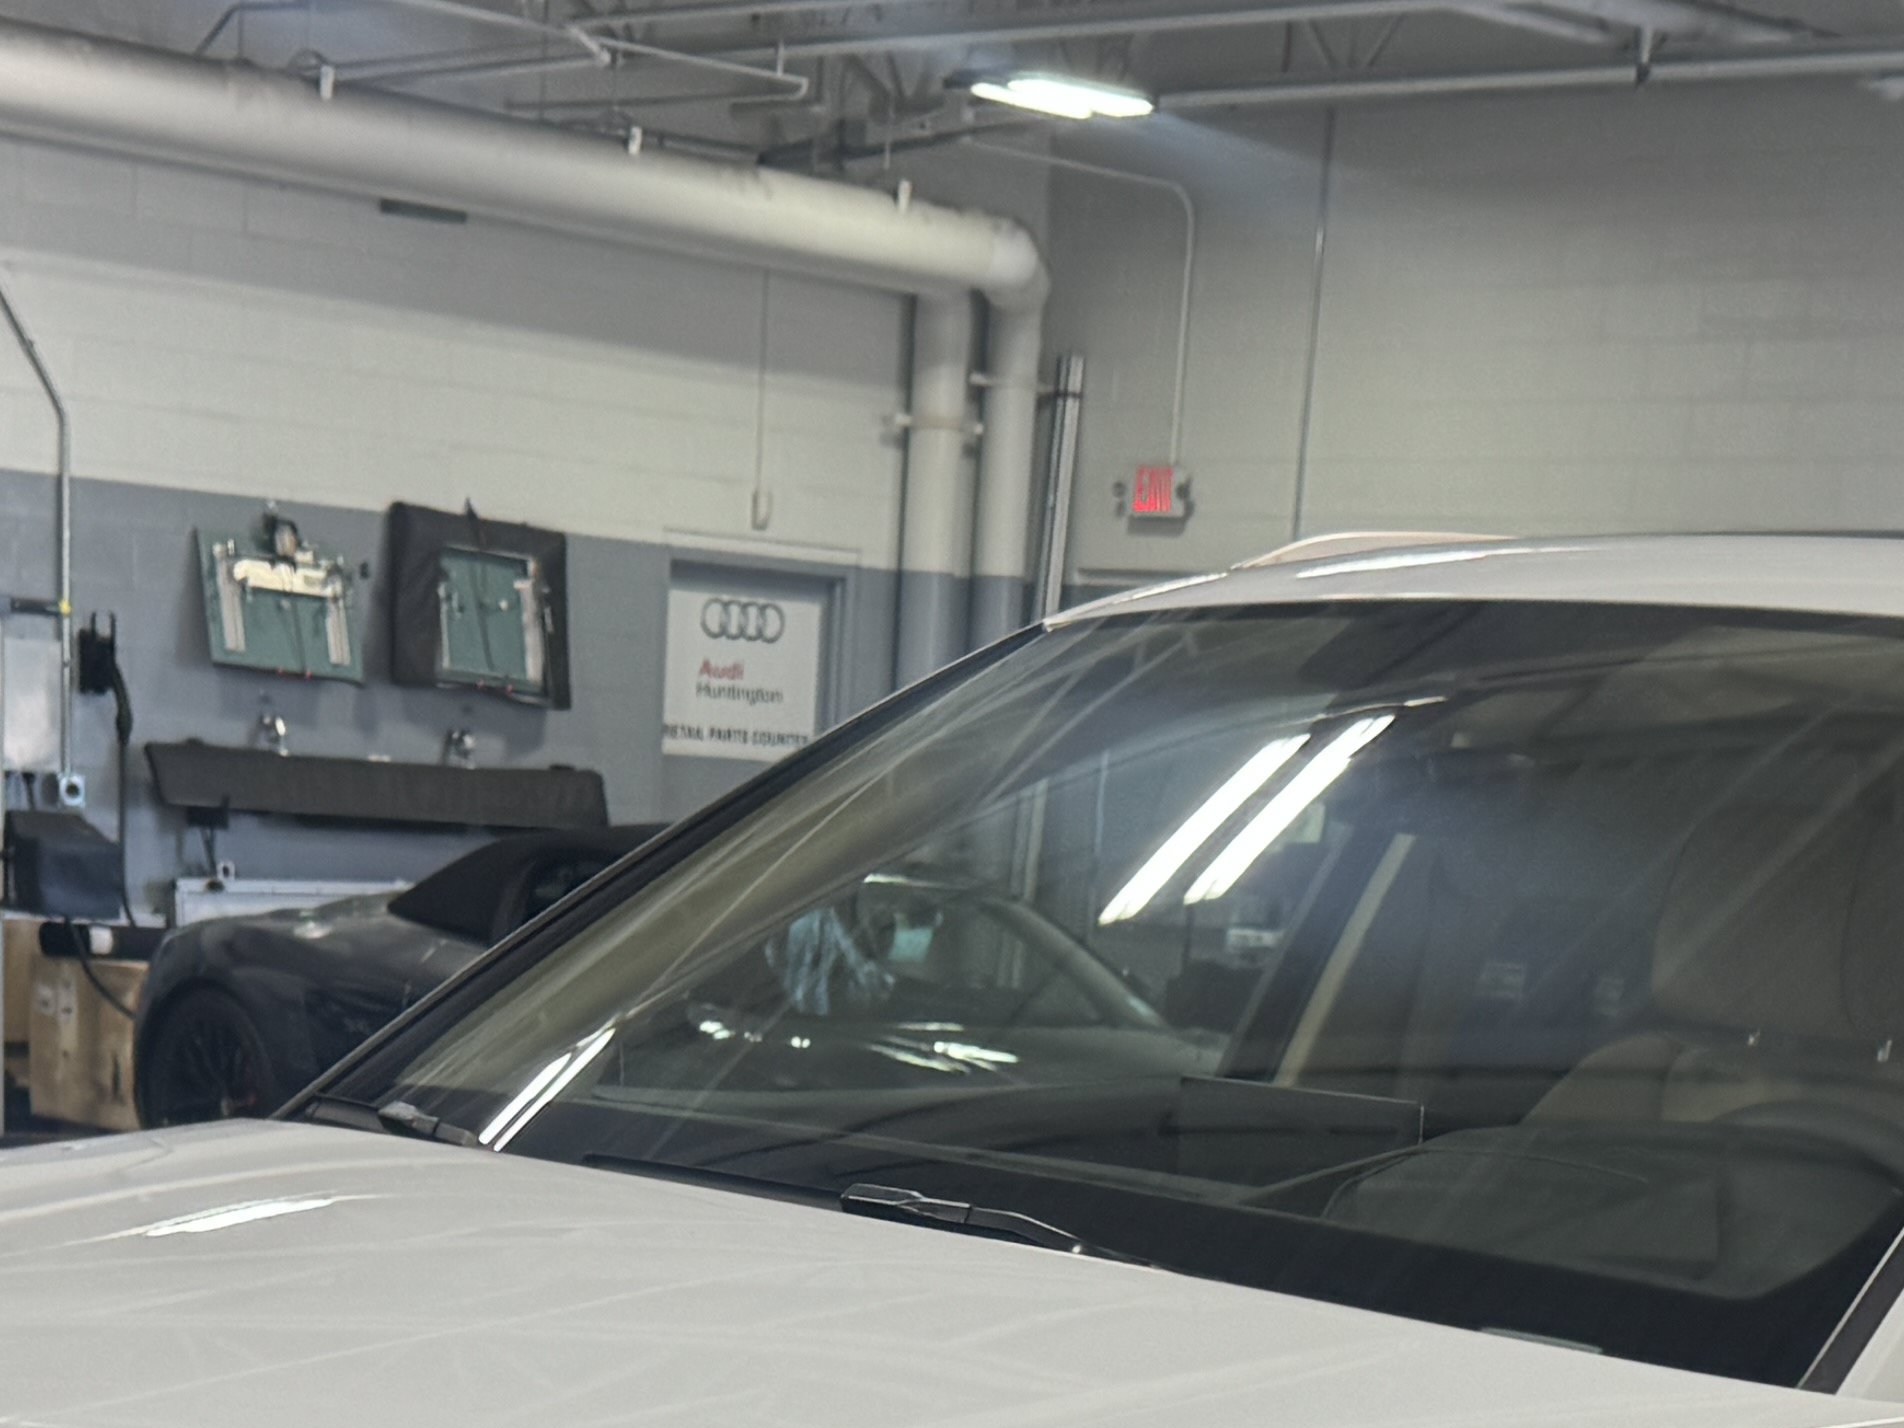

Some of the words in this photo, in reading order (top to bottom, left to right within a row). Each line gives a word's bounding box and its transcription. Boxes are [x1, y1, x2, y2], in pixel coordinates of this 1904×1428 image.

[1132, 465, 1173, 512] EXIT
[698, 659, 745, 680] Audi
[696, 681, 784, 705] Huntington
[709, 727, 748, 744] PARTS
